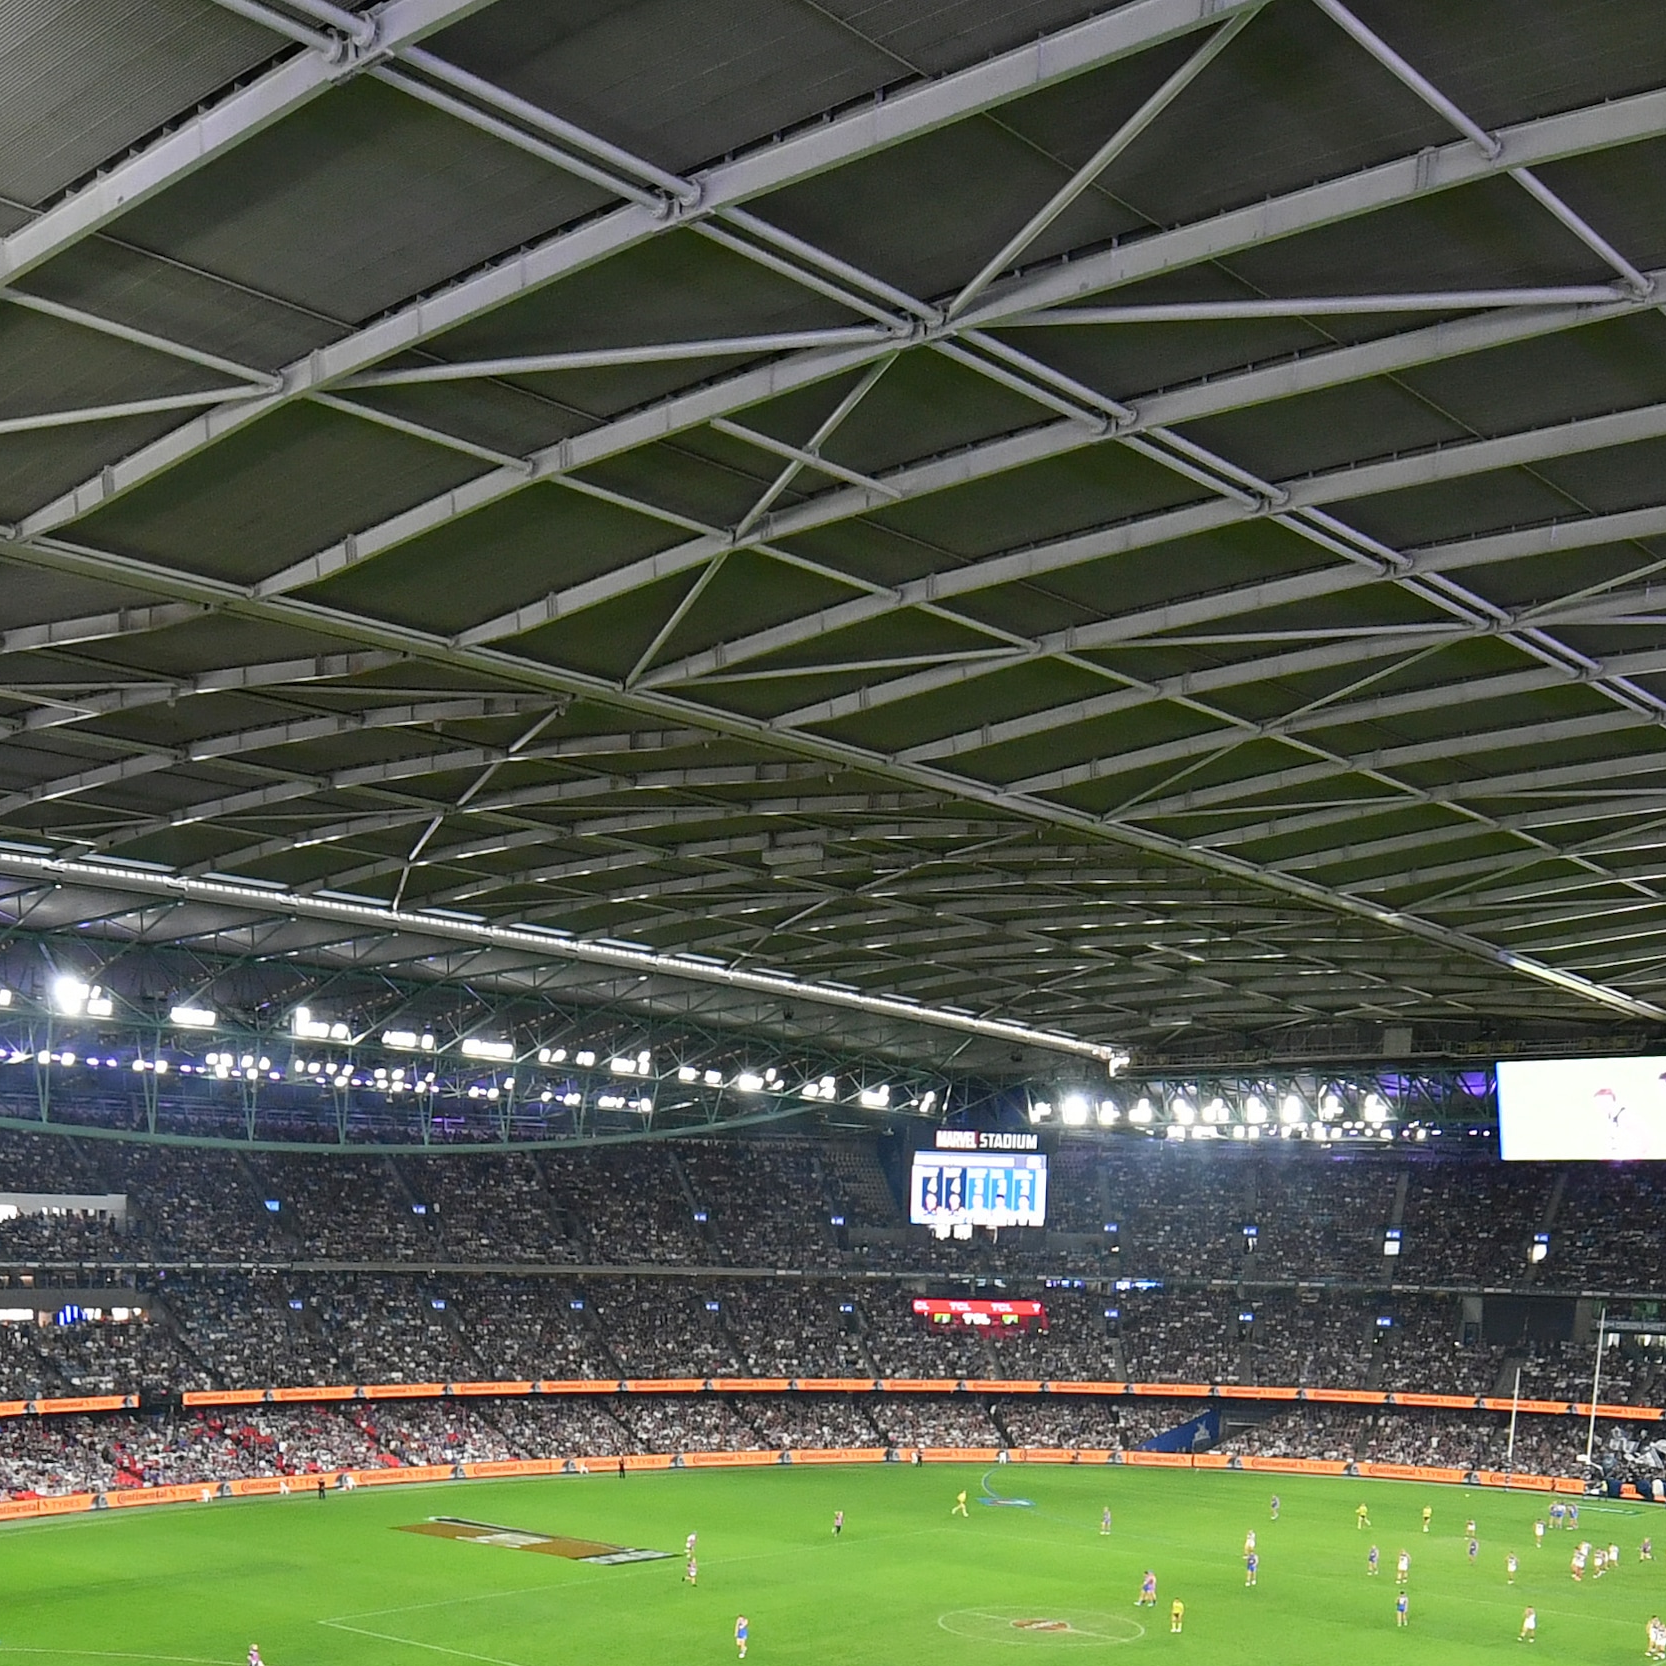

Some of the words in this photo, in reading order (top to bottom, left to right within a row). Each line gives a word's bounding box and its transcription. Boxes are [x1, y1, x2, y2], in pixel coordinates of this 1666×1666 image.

[935, 1129, 977, 1149] MARVEL
[978, 1131, 1038, 1150] STADIUM
[949, 1302, 971, 1311] TCL
[991, 1303, 1013, 1312] TCL
[44, 1399, 84, 1411] Continental
[117, 1487, 168, 1505] Continental
